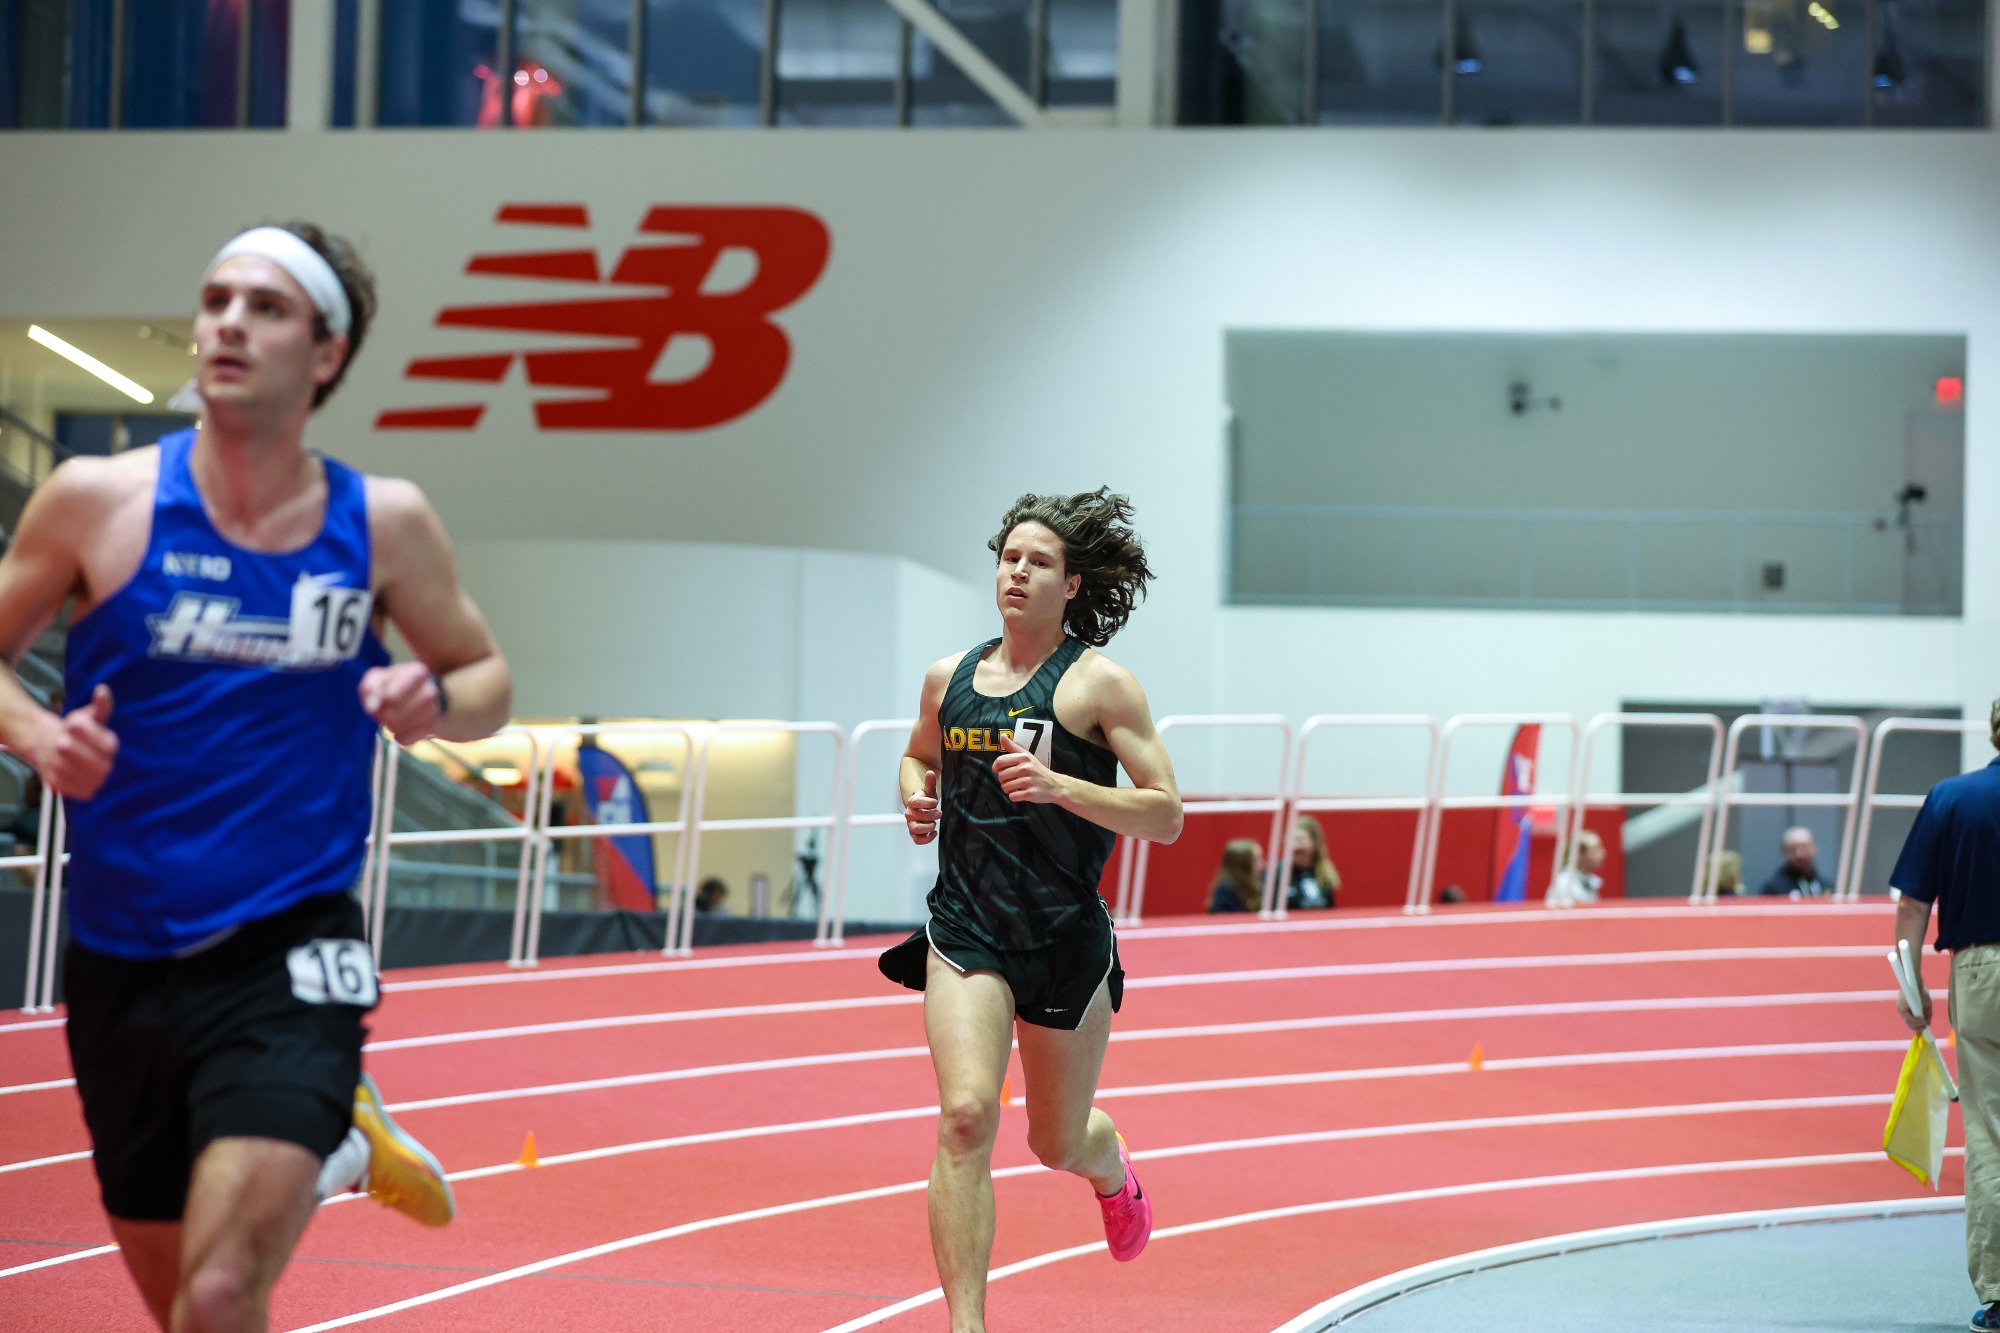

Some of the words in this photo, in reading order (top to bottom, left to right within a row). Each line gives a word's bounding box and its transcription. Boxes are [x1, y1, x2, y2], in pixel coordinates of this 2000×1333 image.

[372, 203, 834, 432] NB
[313, 594, 359, 652] 16
[943, 726, 1015, 751] ADELP
[1023, 721, 1045, 756] 7
[308, 947, 362, 995] 16
